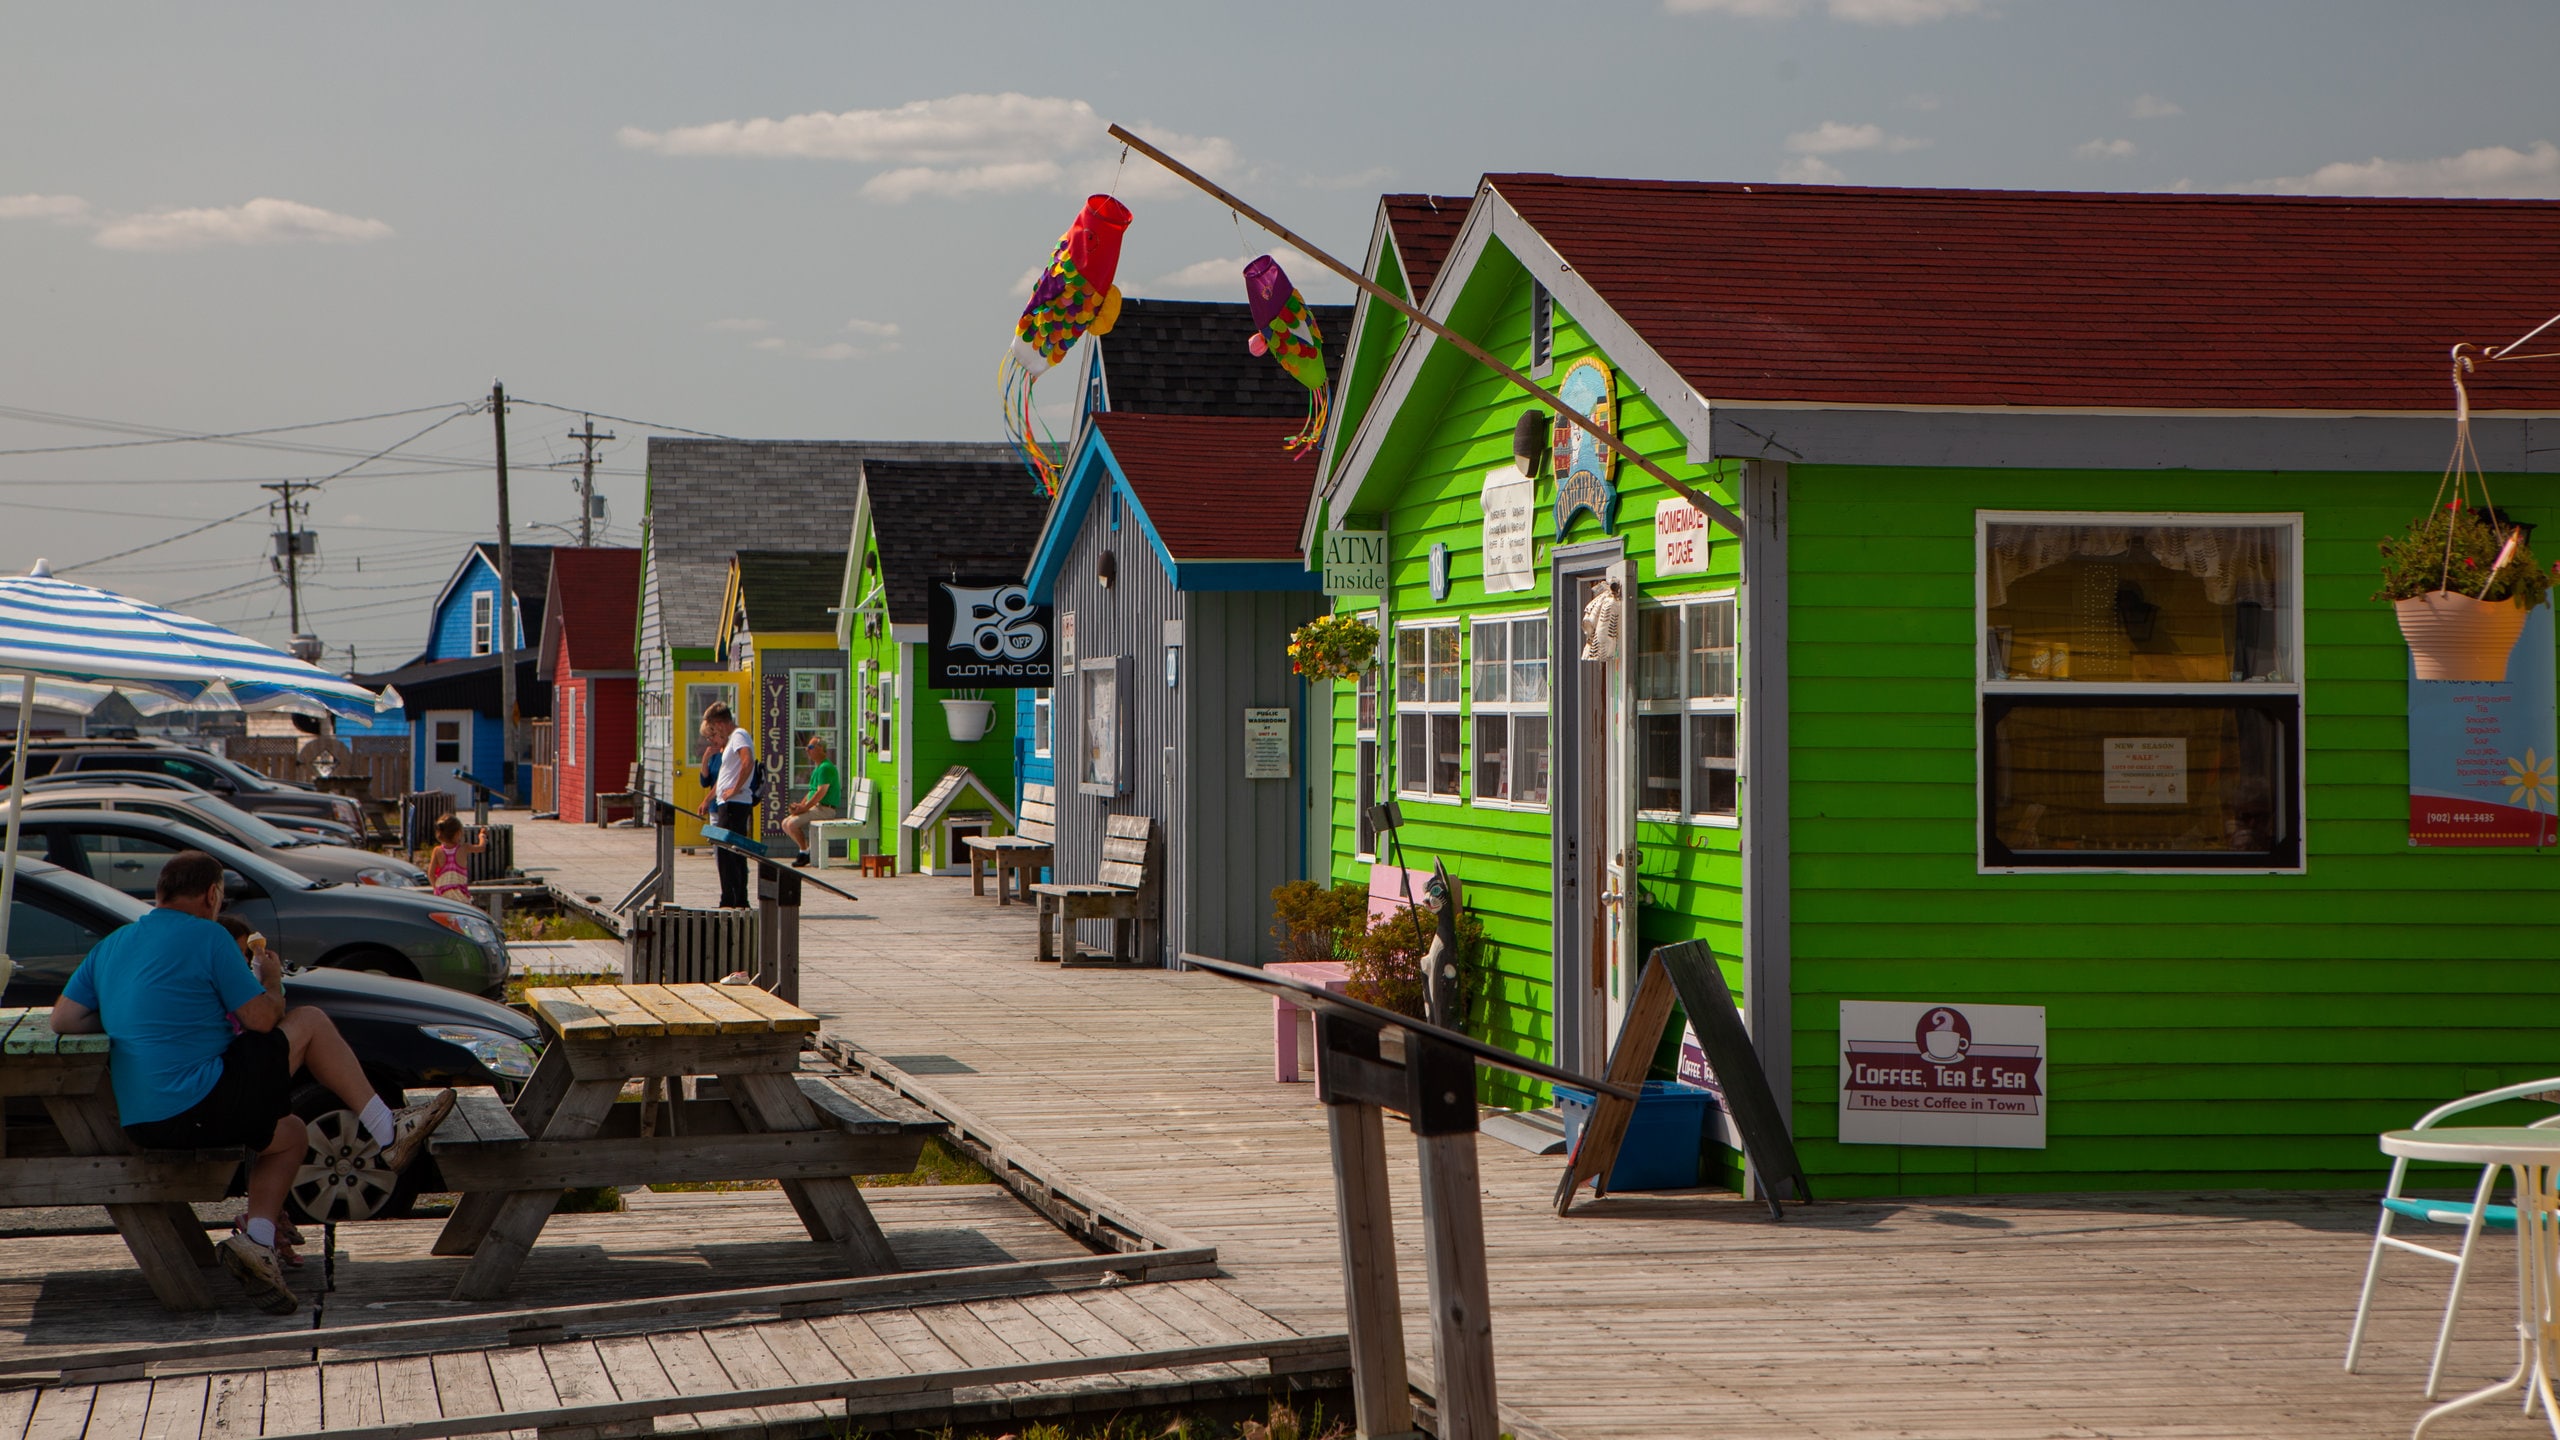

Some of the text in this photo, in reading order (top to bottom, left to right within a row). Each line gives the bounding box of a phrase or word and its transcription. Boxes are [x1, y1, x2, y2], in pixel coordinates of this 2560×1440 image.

[1658, 506, 1704, 535] HOMEMADE
[1325, 537, 1383, 564] ATM
[1667, 540, 1694, 565] FUDGE
[1326, 569, 1385, 589] Inside
[1430, 550, 1442, 592] 18
[947, 664, 1053, 676] CLOTHING CO.
[2427, 812, 2495, 824] (902) 444-3435
[1855, 1062, 2026, 1089] COFFEE, TEA & SEA
[1860, 1095, 2025, 1110] The best Coffee in Town
